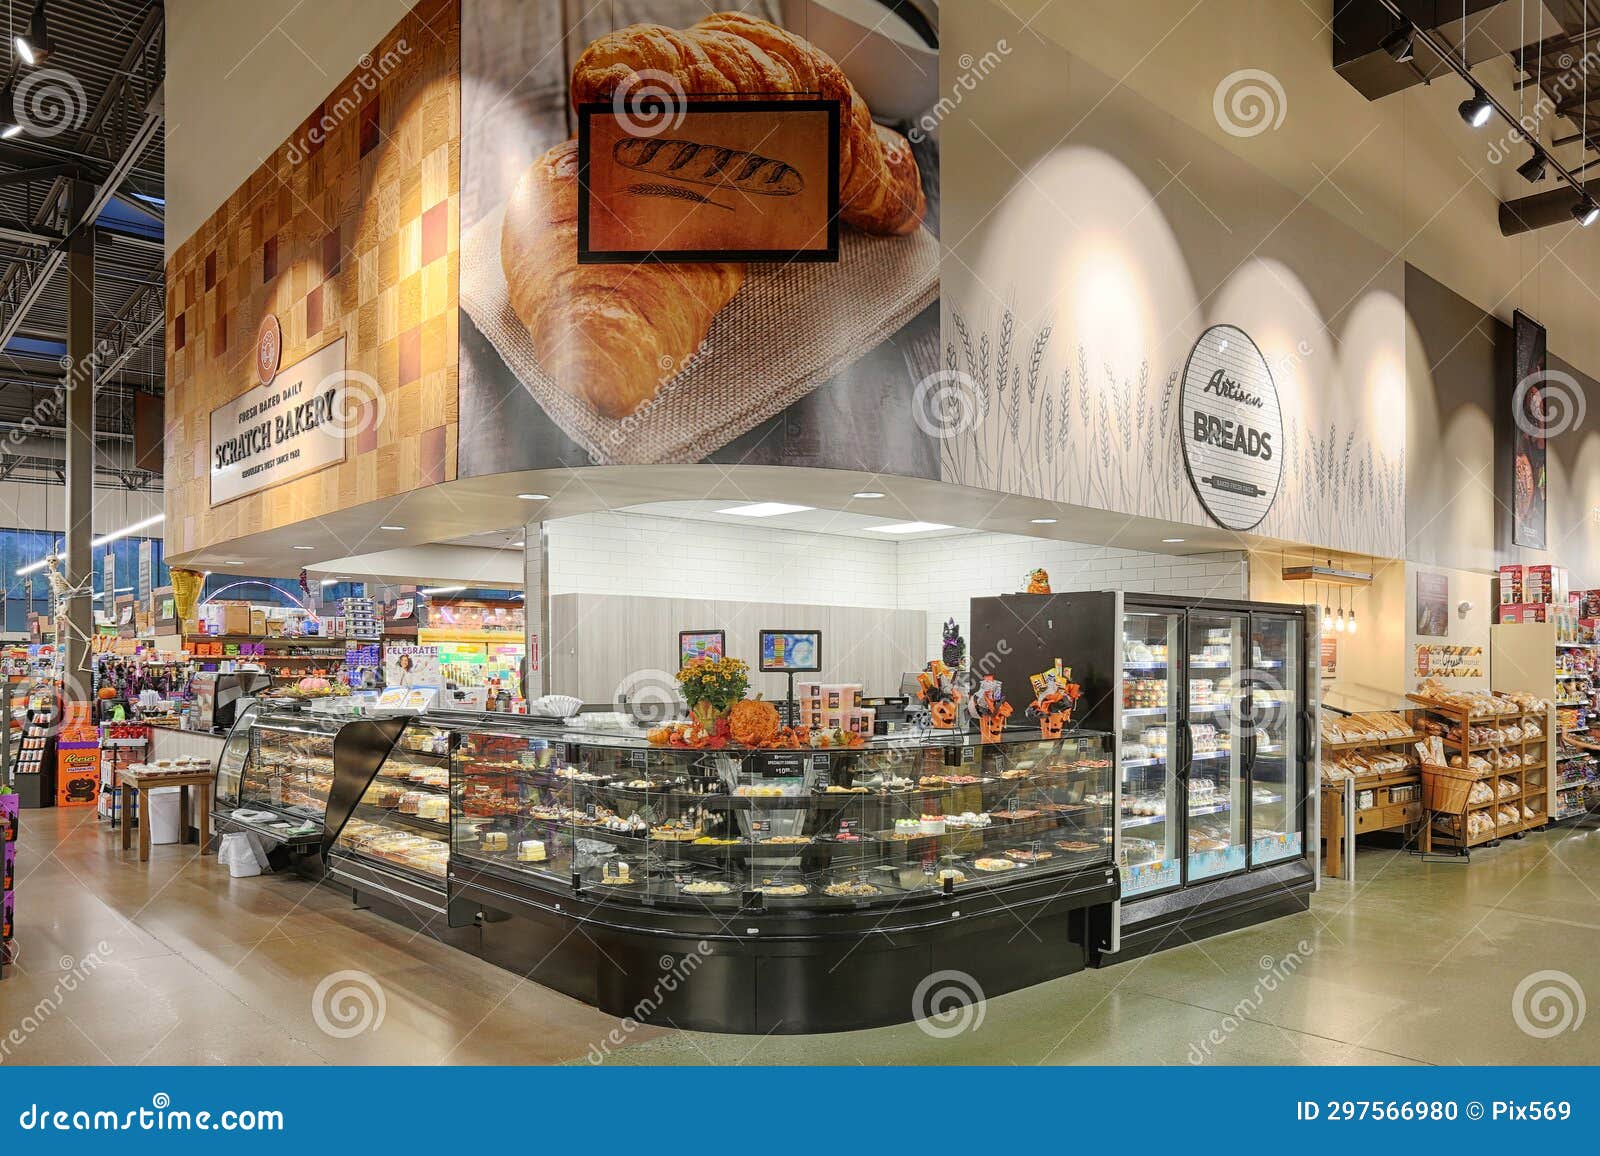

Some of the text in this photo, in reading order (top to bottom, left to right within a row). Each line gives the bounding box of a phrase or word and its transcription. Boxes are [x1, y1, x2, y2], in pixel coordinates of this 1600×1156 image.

[238, 381, 303, 424] FRESH BAKED DAILY
[1204, 369, 1263, 408] Artisan
[215, 388, 336, 469] SCRATCH BAKERY
[1193, 411, 1273, 461] BREADS
[386, 645, 439, 655] CELEBRATE!
